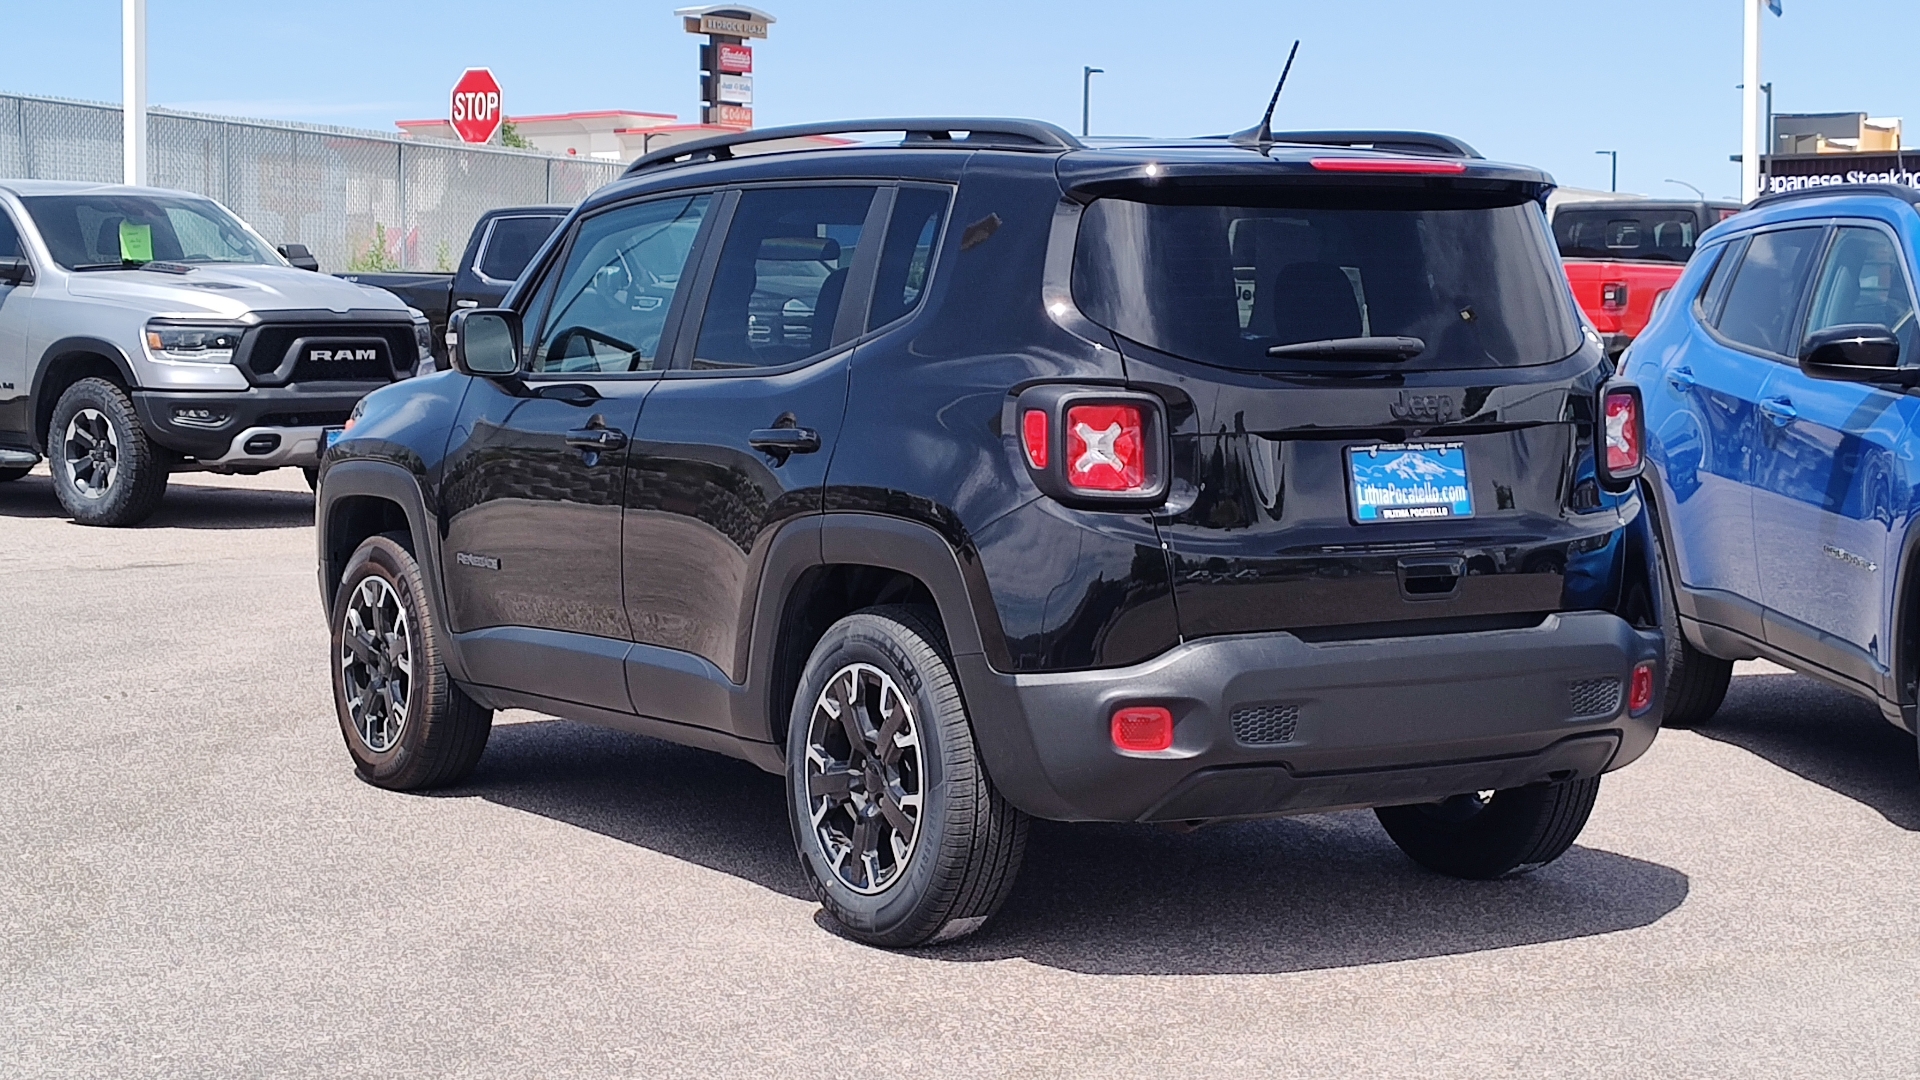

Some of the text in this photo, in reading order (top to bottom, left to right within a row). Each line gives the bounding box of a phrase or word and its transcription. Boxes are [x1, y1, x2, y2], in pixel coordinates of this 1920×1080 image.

[743, 24, 766, 34] PLAZA
[453, 91, 499, 121] STOP
[310, 349, 377, 361] RAM
[1390, 390, 1453, 424] Jeep
[1356, 482, 1467, 505] LithiaPocatello.com
